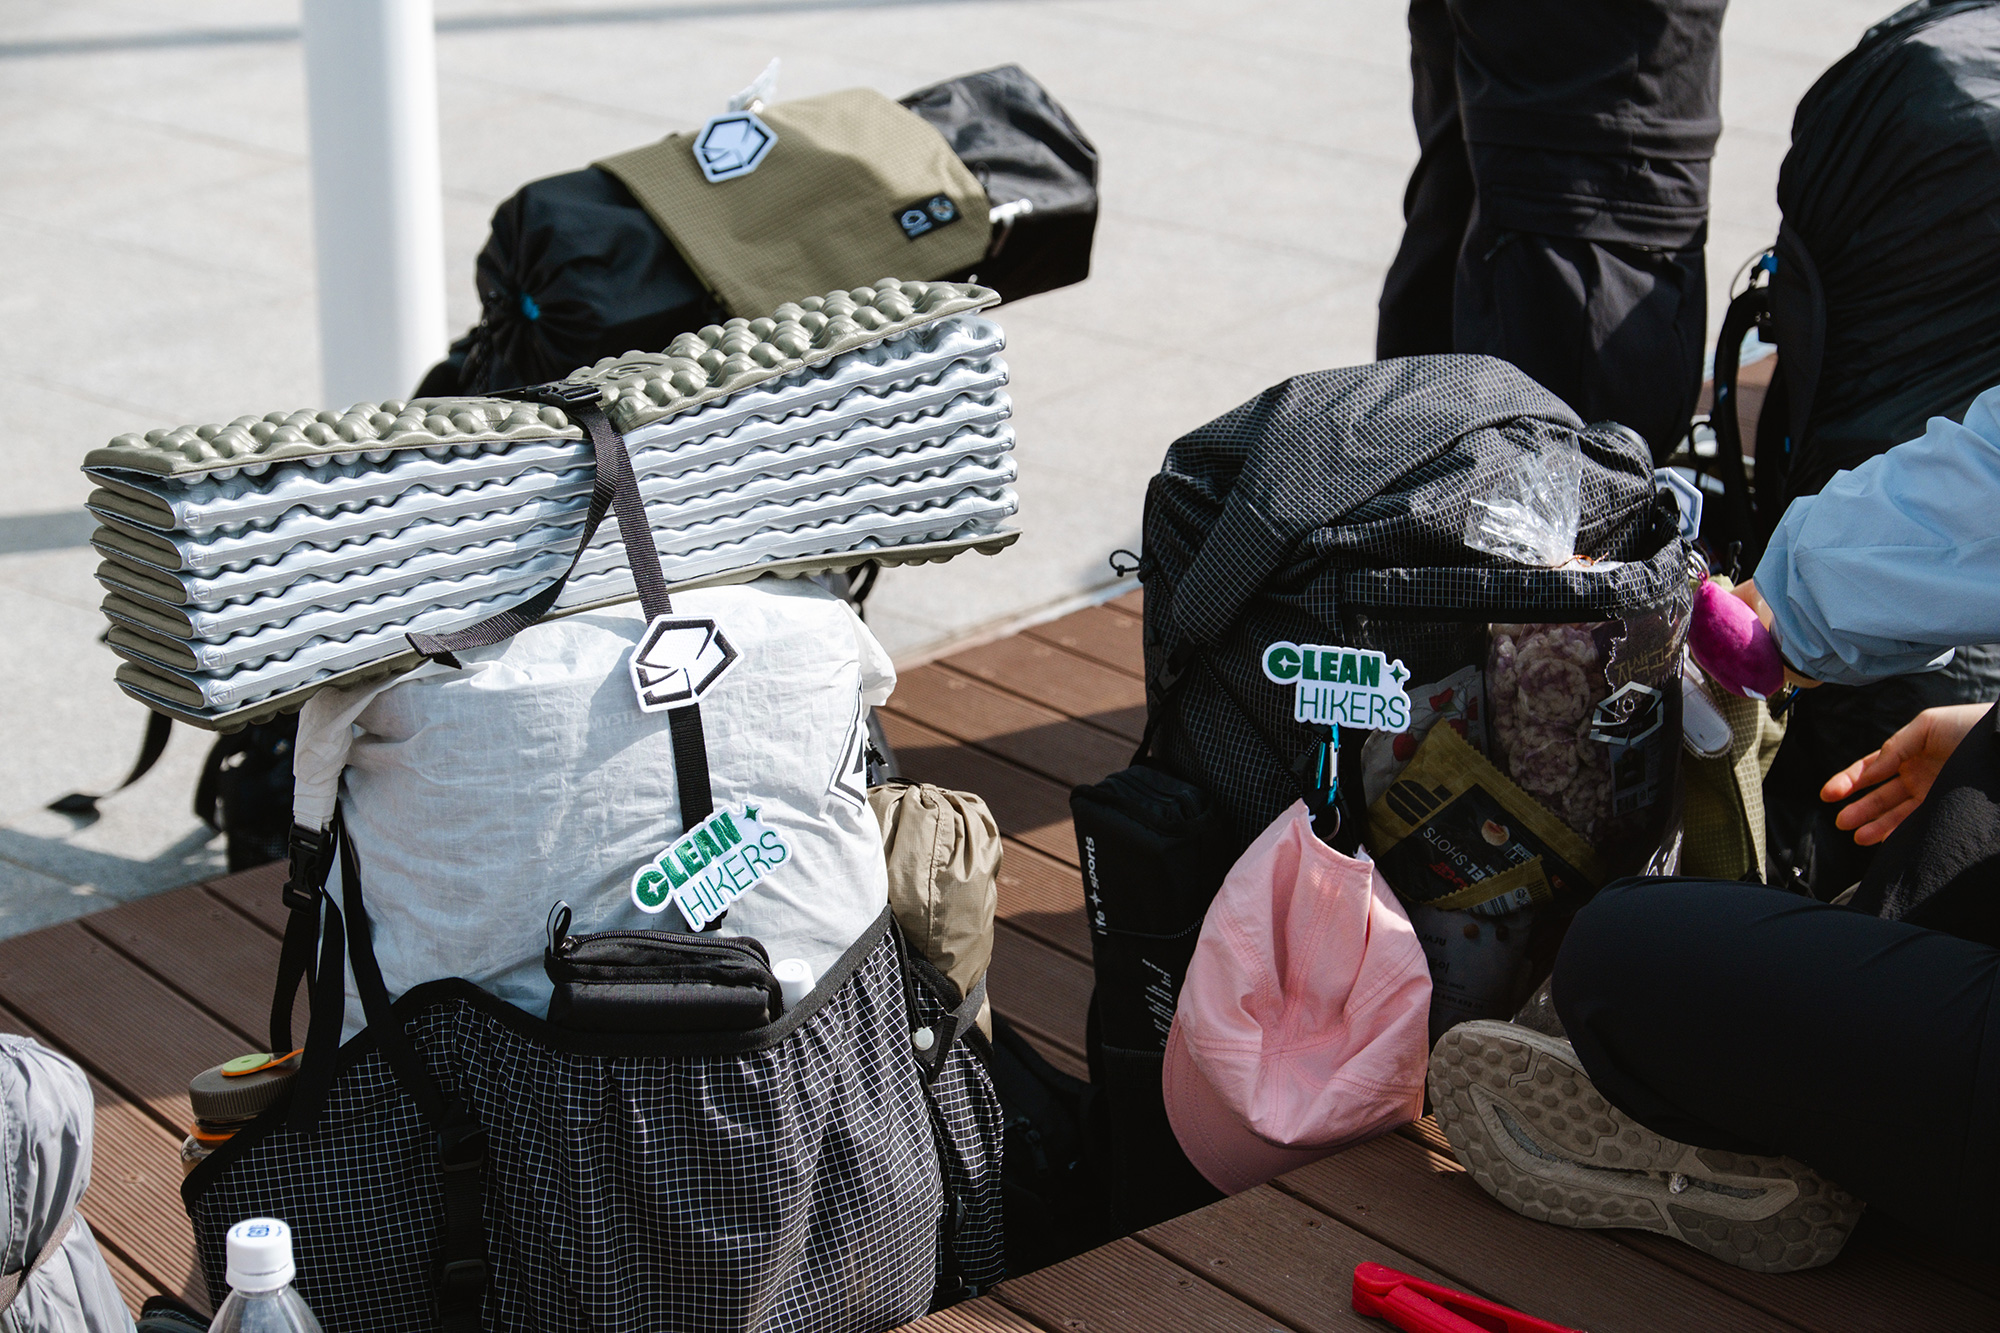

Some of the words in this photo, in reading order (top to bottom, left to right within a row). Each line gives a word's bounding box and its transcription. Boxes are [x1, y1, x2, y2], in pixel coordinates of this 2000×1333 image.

[1268, 647, 1380, 688] CLEAN
[1299, 686, 1405, 728] HIKERS
[636, 812, 743, 907] CLEAN
[1086, 836, 1100, 889] sports
[1423, 827, 1468, 866] SHOTS
[679, 831, 787, 926] HIKERS
[1095, 910, 1108, 935] lfe
